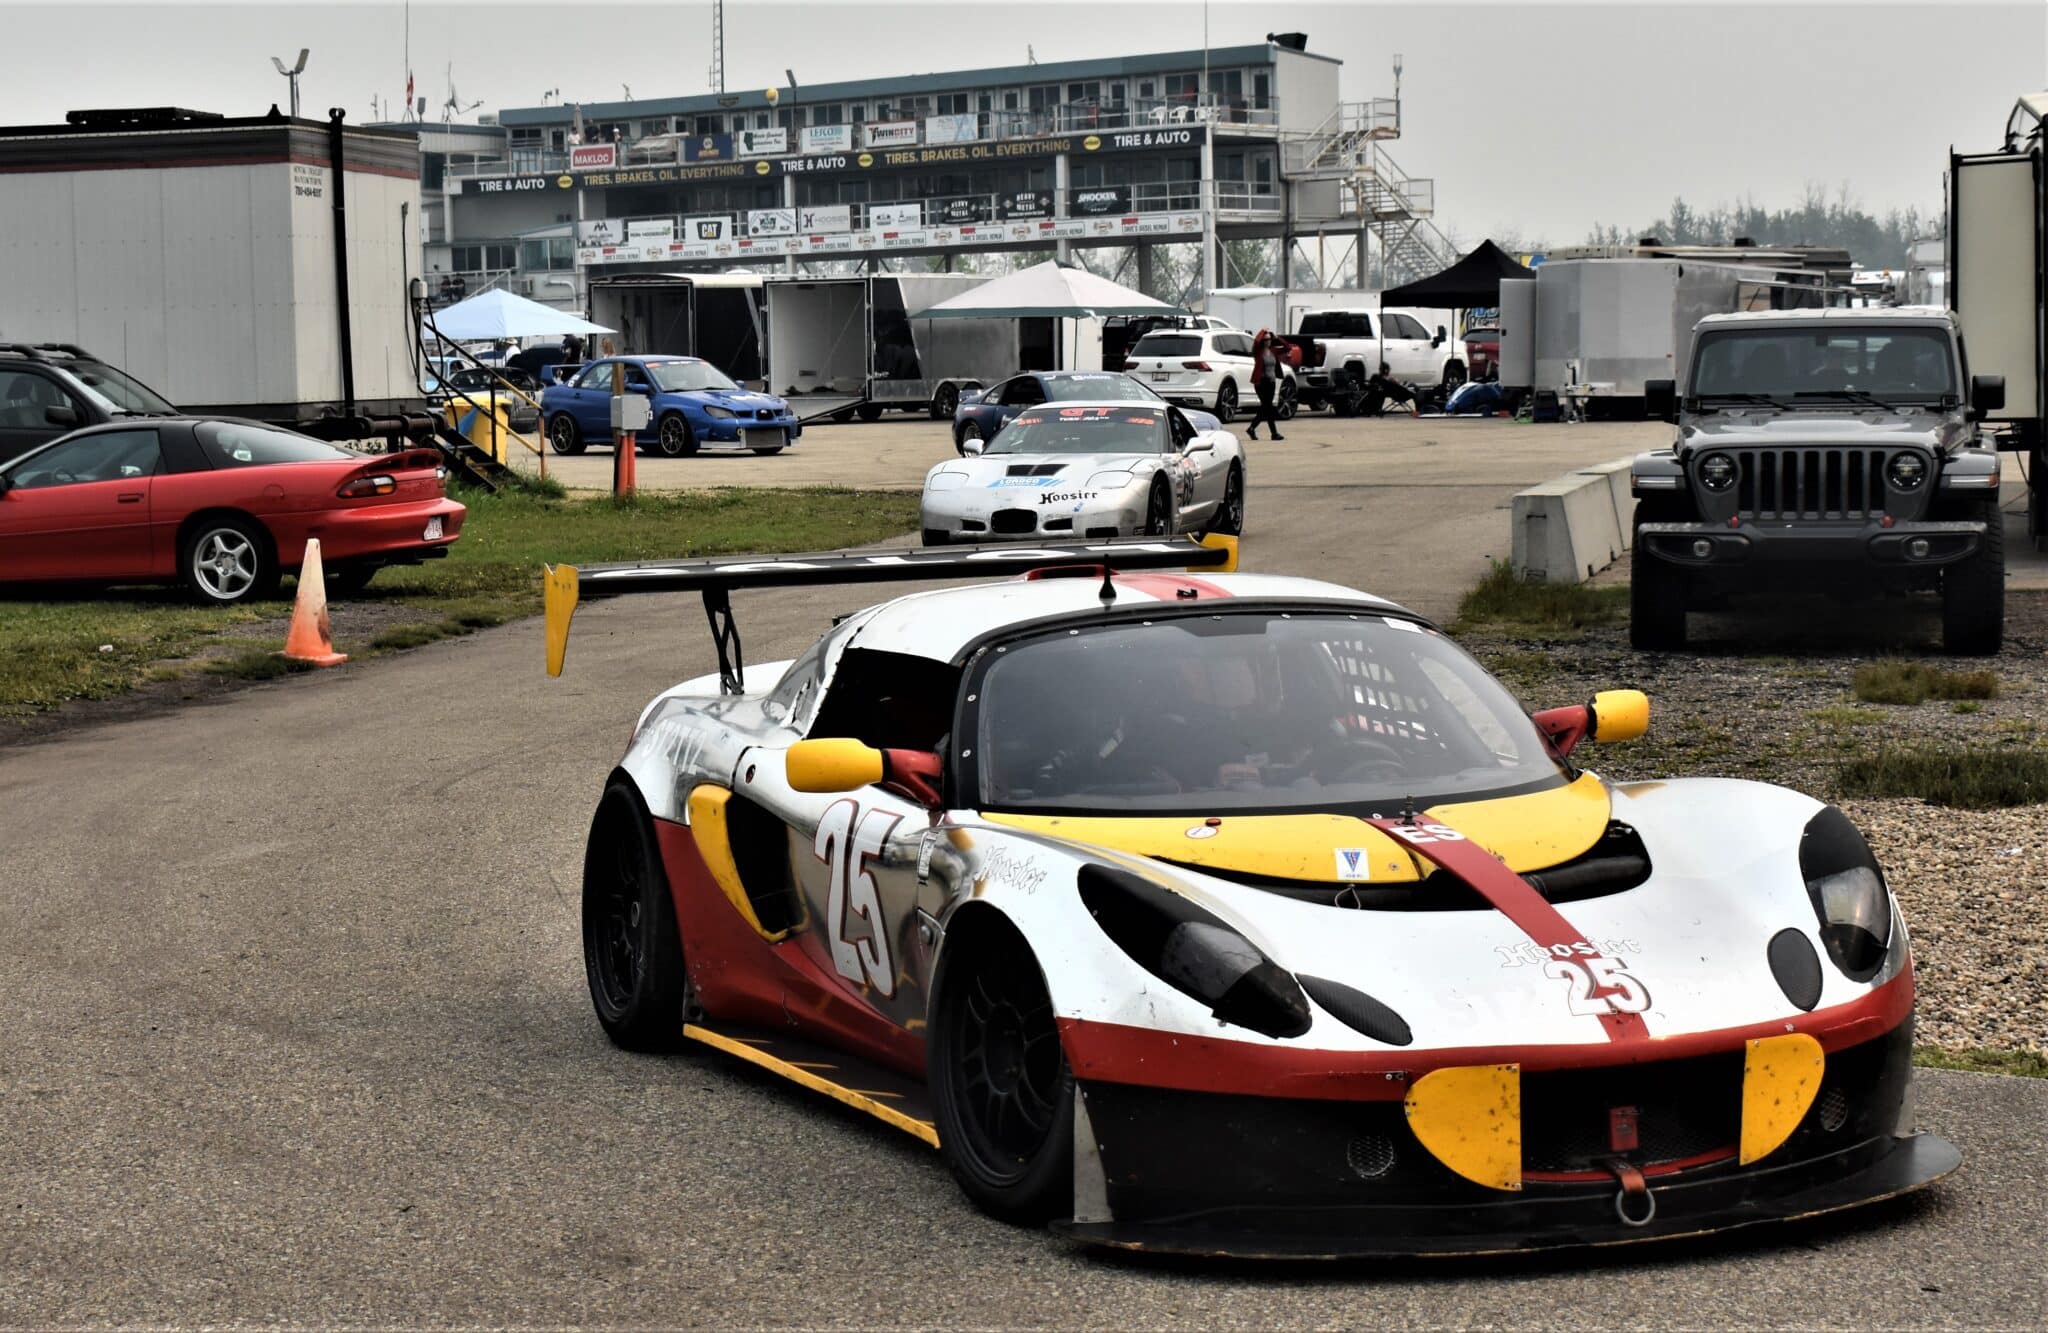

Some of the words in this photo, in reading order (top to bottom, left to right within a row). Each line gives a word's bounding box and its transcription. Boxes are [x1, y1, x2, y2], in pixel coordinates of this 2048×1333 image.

[1114, 134, 1141, 147] TIRE
[1143, 134, 1152, 145] &
[1155, 131, 1191, 144] AUTO
[997, 140, 1071, 156] EVERYTHING
[574, 153, 609, 165] MAKLOC
[781, 160, 804, 172] TIRE
[806, 159, 814, 170] &
[816, 157, 846, 169] AUTO
[680, 165, 744, 179] EVERYTHING
[478, 181, 503, 192] TIRE
[505, 181, 512, 190] &
[515, 178, 545, 190] AUTO
[701, 223, 718, 238] CAT
[1059, 407, 1119, 416] GT
[1388, 823, 1466, 844] ES
[814, 798, 905, 1000] 25
[1544, 957, 1652, 1016] 25
